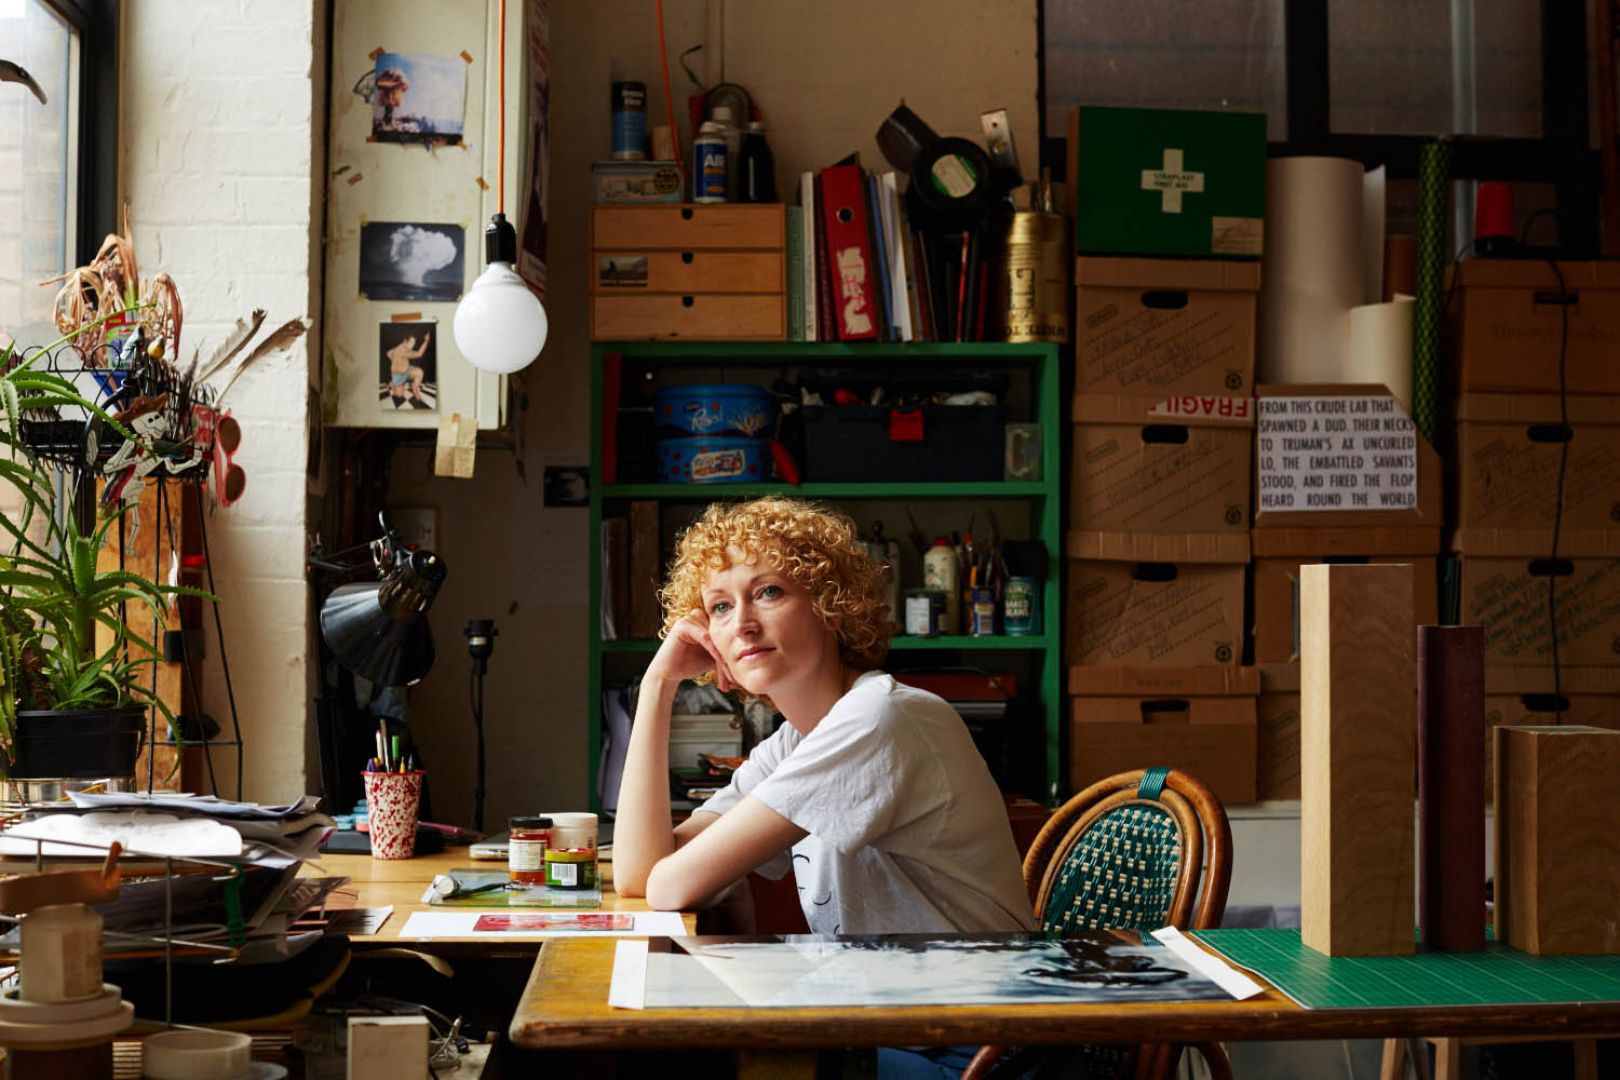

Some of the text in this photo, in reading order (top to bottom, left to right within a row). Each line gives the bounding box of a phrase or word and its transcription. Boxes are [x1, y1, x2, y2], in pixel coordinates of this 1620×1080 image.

[1259, 400, 1394, 414] FROM THIS CRUDE LAB THAT
[1260, 418, 1306, 432] SPAWNED
[1313, 418, 1319, 432] A
[1353, 418, 1380, 432] THEIR
[1383, 418, 1414, 432] NECKS
[1260, 437, 1414, 452] TO TRUMAN'S AX UNCURLED
[1261, 455, 1414, 472] LO, THE EMBATTLED SAVANTS
[1261, 474, 1414, 490] STOOD, AND FIRED THE FLOP
[1261, 492, 1415, 507] HEARD ROUND THE WORLD
